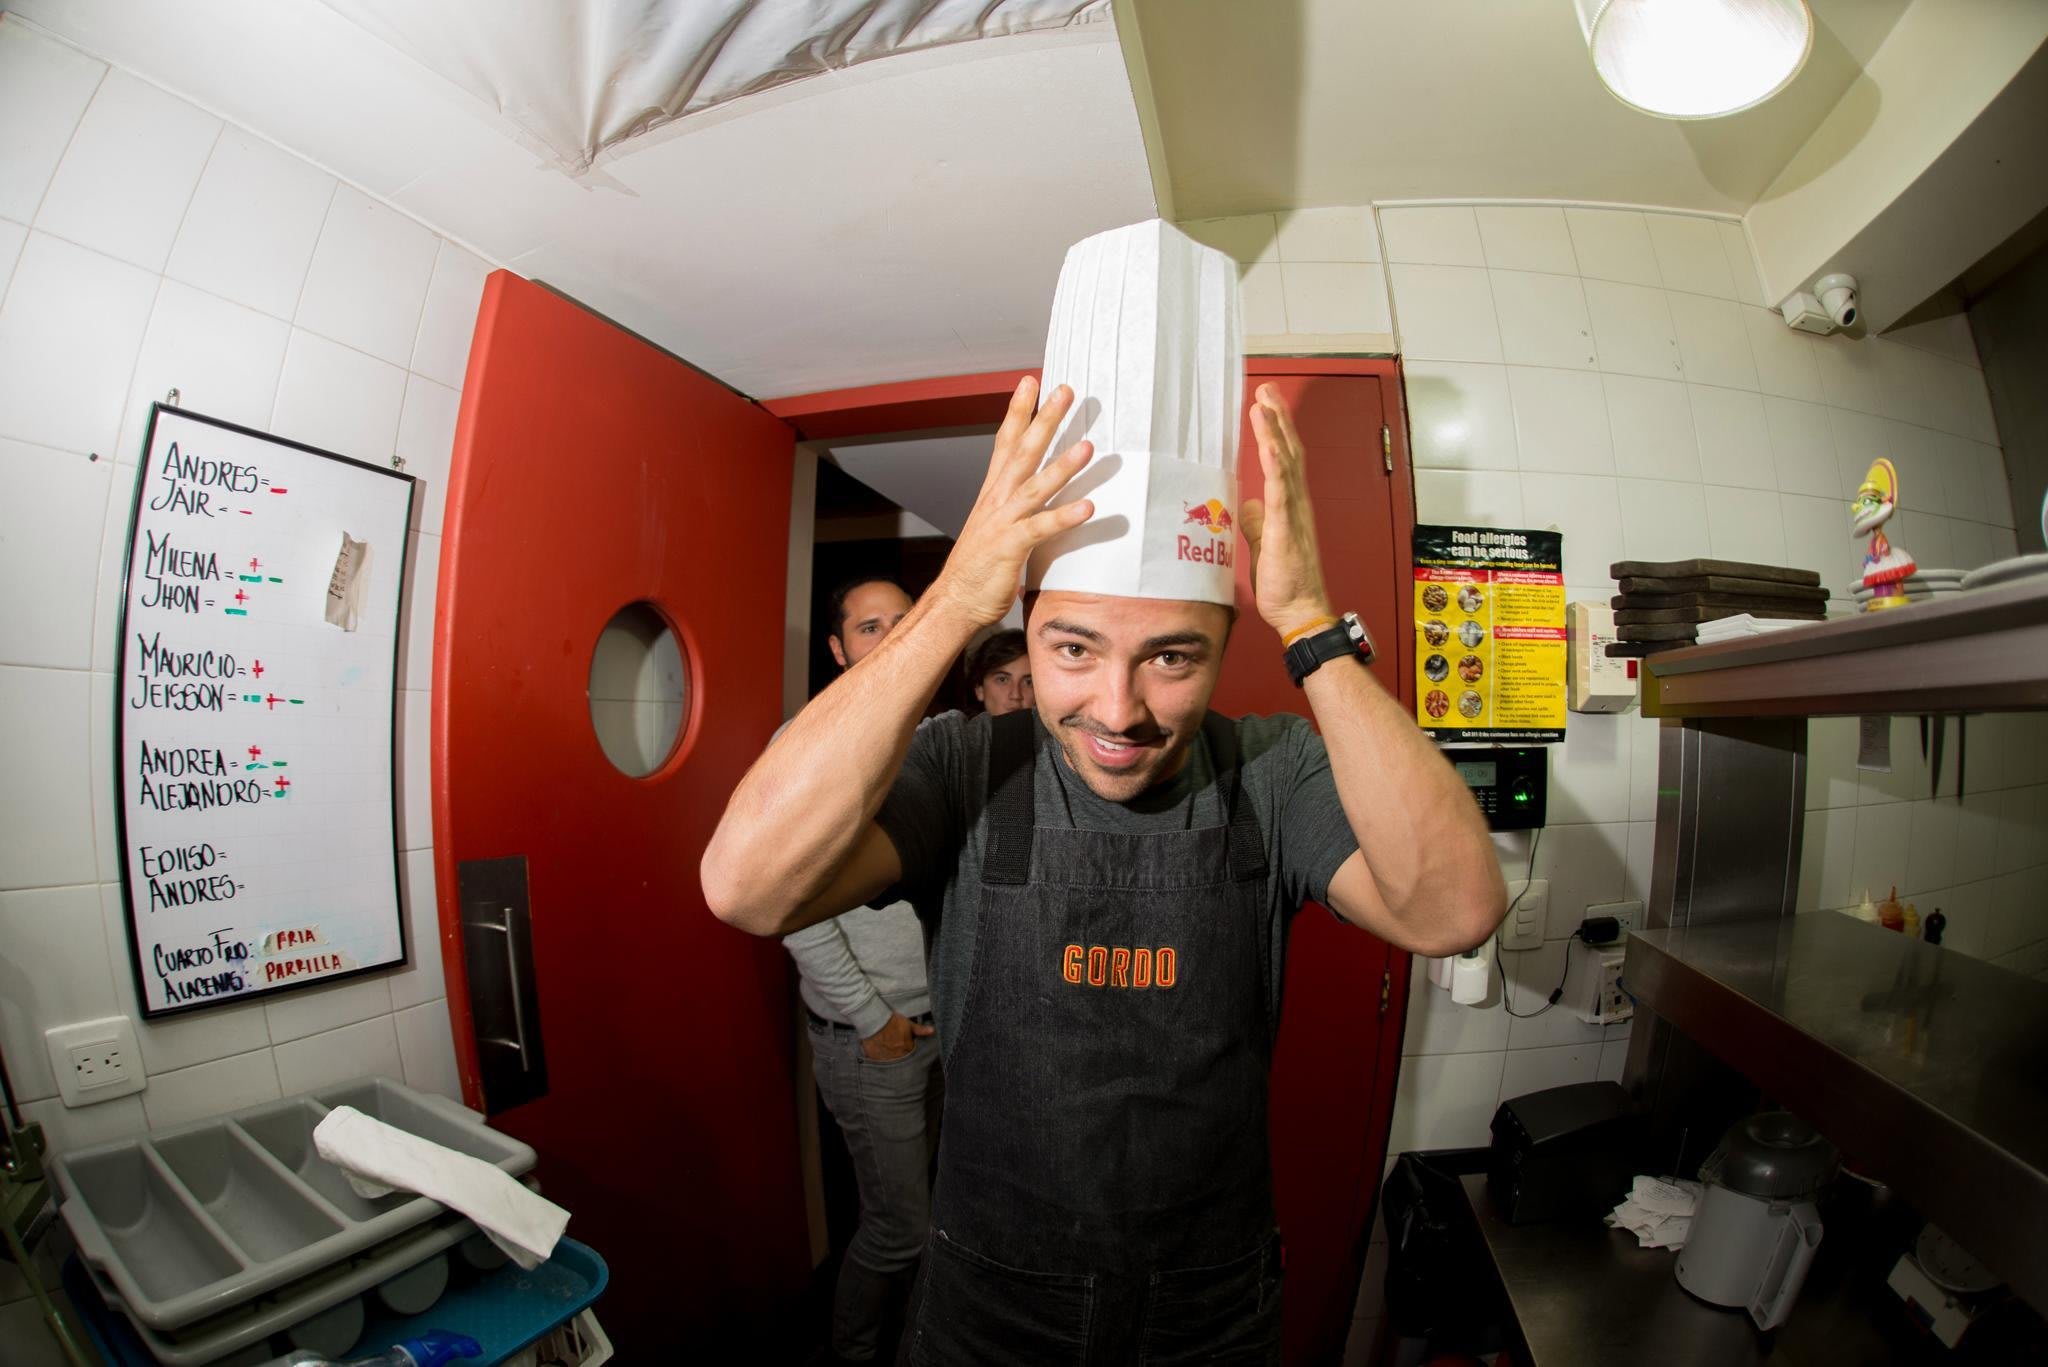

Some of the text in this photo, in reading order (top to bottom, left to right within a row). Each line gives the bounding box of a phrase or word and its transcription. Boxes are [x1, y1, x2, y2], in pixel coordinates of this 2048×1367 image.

[1177, 535, 1214, 564] Red
[1452, 531, 1528, 546] Food allergies
[1451, 546, 1472, 557] can
[1473, 545, 1487, 558] be
[276, 929, 316, 950] FRIA
[265, 954, 342, 982] PARRILLA
[1063, 944, 1177, 988] GORDO
